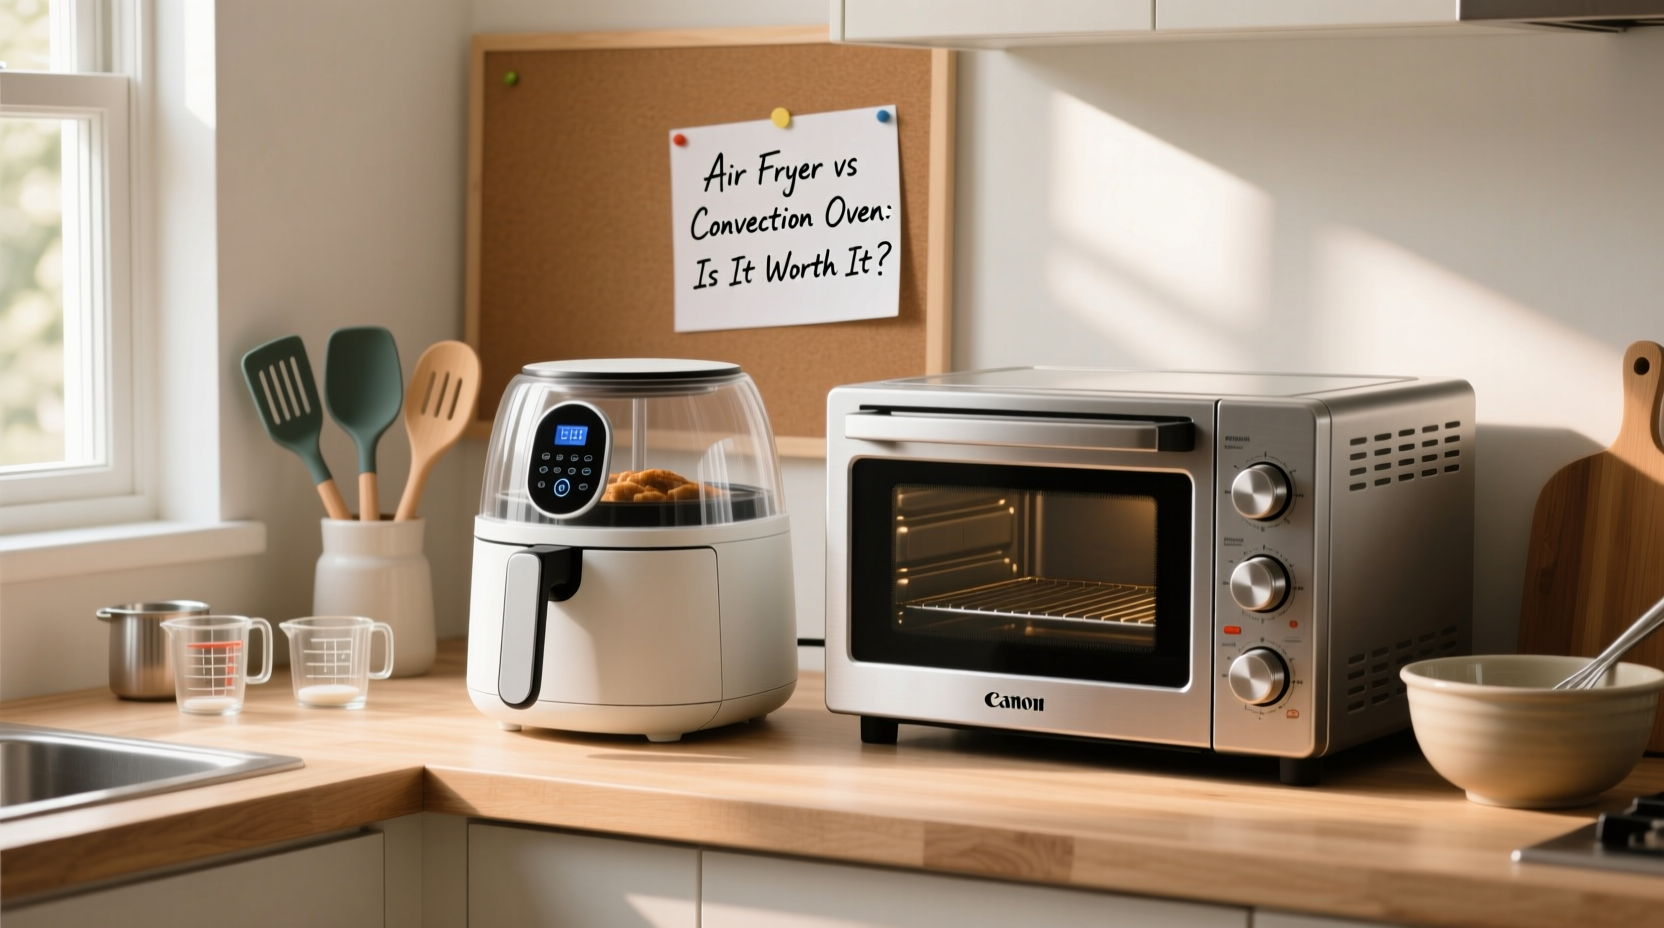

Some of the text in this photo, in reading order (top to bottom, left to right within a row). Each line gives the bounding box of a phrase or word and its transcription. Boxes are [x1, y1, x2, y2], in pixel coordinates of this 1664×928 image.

[703, 149, 858, 198] Air Fryer vs
[690, 195, 892, 241] Convection Oven:
[692, 240, 893, 290] Is It Worth It?
[984, 691, 1045, 712] Canon
